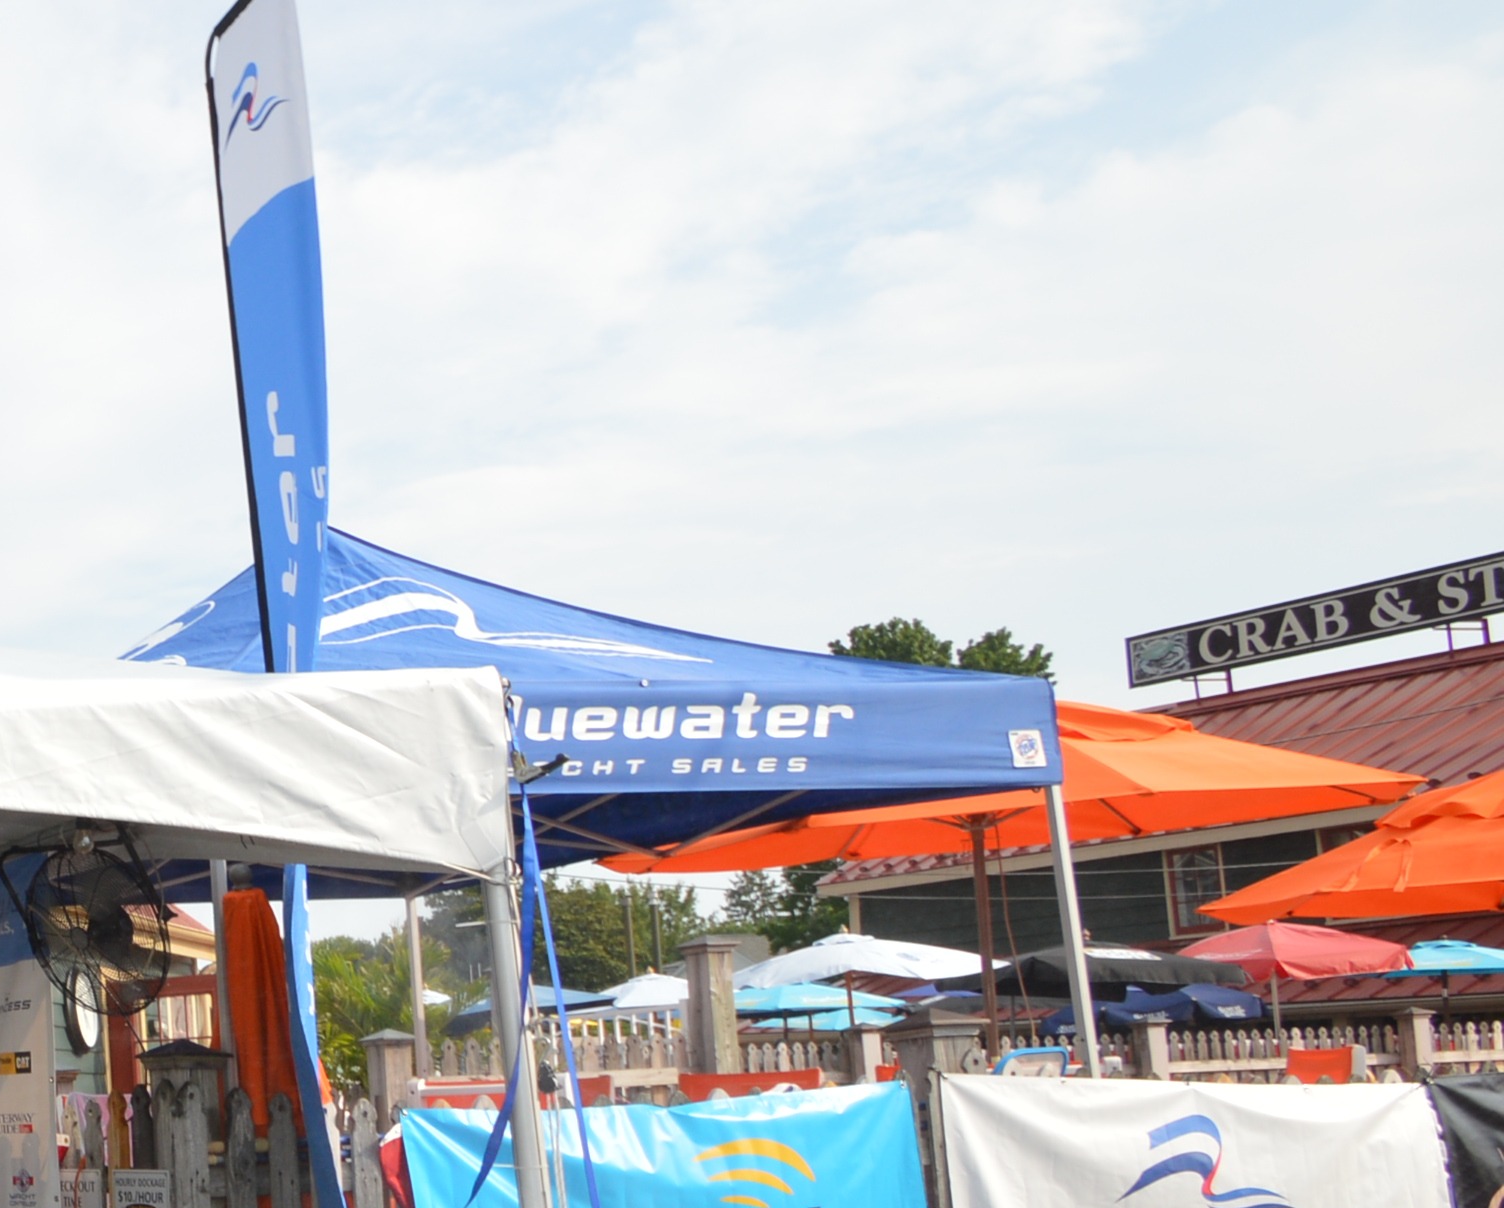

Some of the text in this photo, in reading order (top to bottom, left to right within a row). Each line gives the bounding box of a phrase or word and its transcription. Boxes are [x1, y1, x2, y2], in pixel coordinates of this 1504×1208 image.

[1198, 598, 1350, 664] CRAB
[1369, 586, 1421, 629] &
[671, 757, 810, 775] SALES
[15, 1056, 30, 1069] CAT
